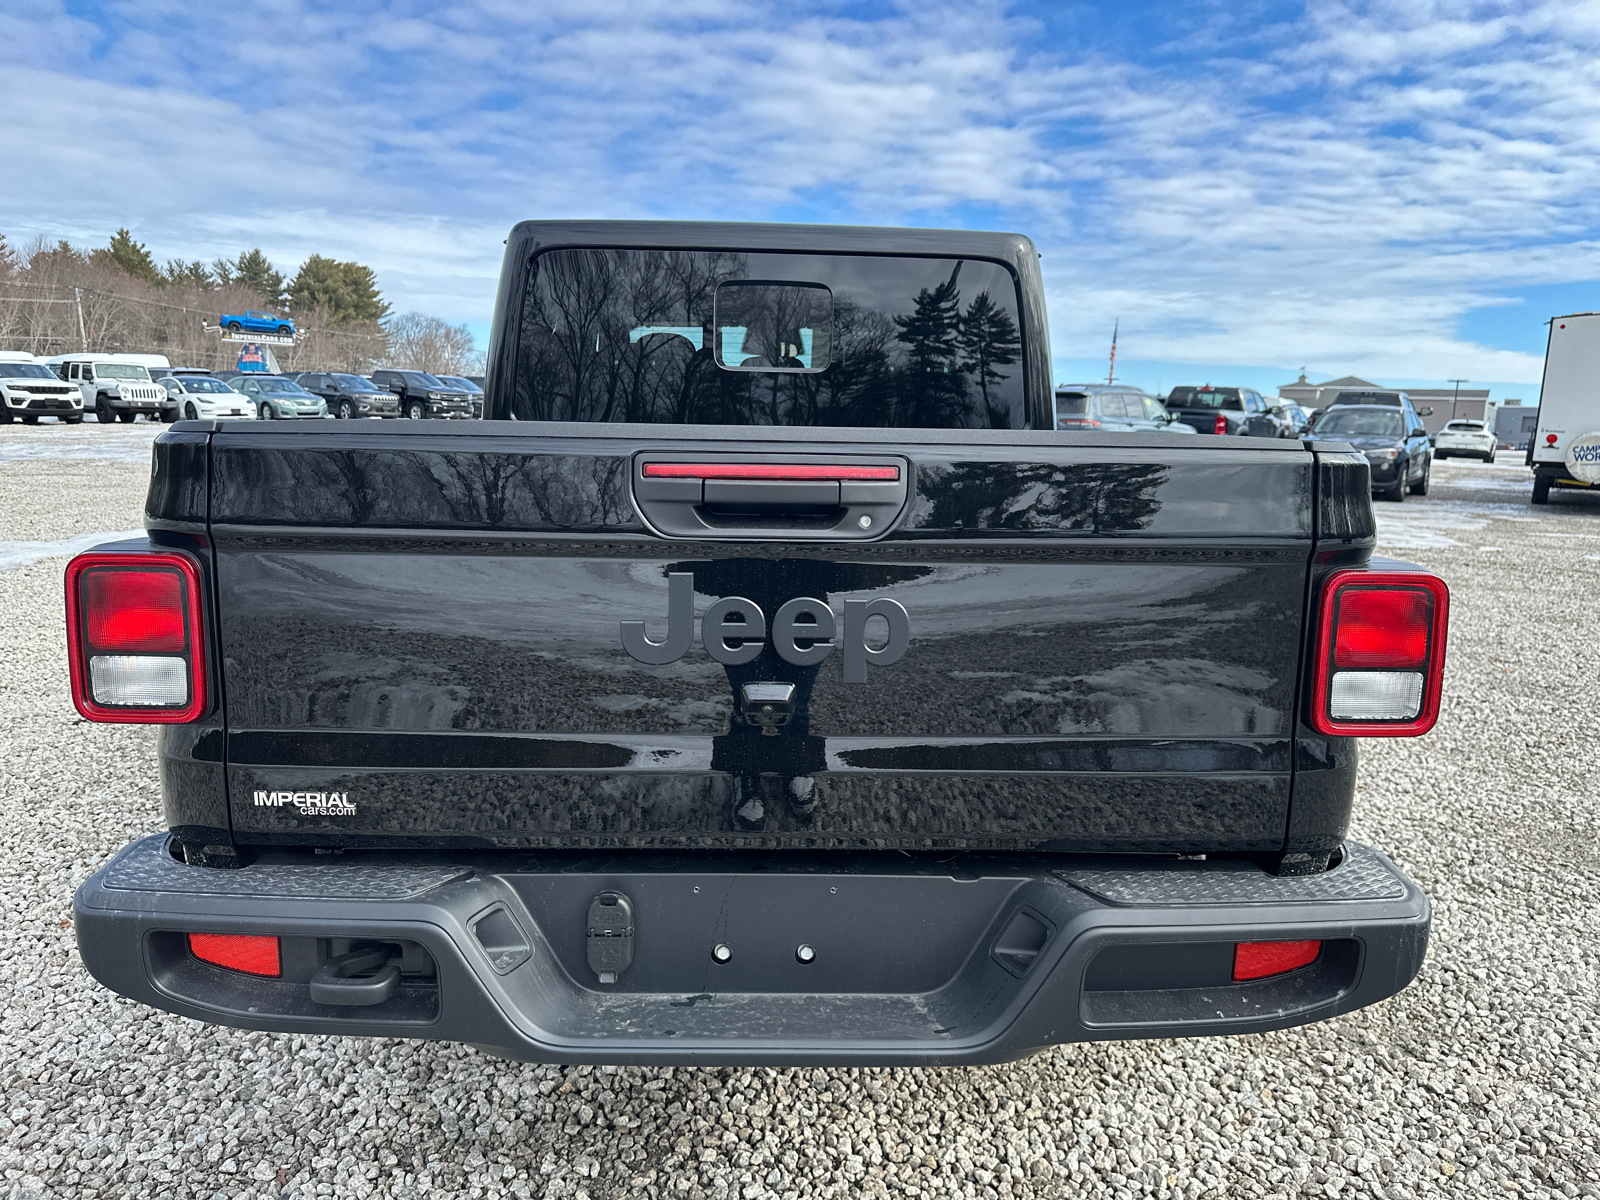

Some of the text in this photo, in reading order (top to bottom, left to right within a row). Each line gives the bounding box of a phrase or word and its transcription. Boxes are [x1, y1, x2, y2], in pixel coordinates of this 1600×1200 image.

[620, 572, 909, 684] Jeep
[253, 790, 357, 808] IMPERIAL
[300, 807, 356, 816] cars.com
